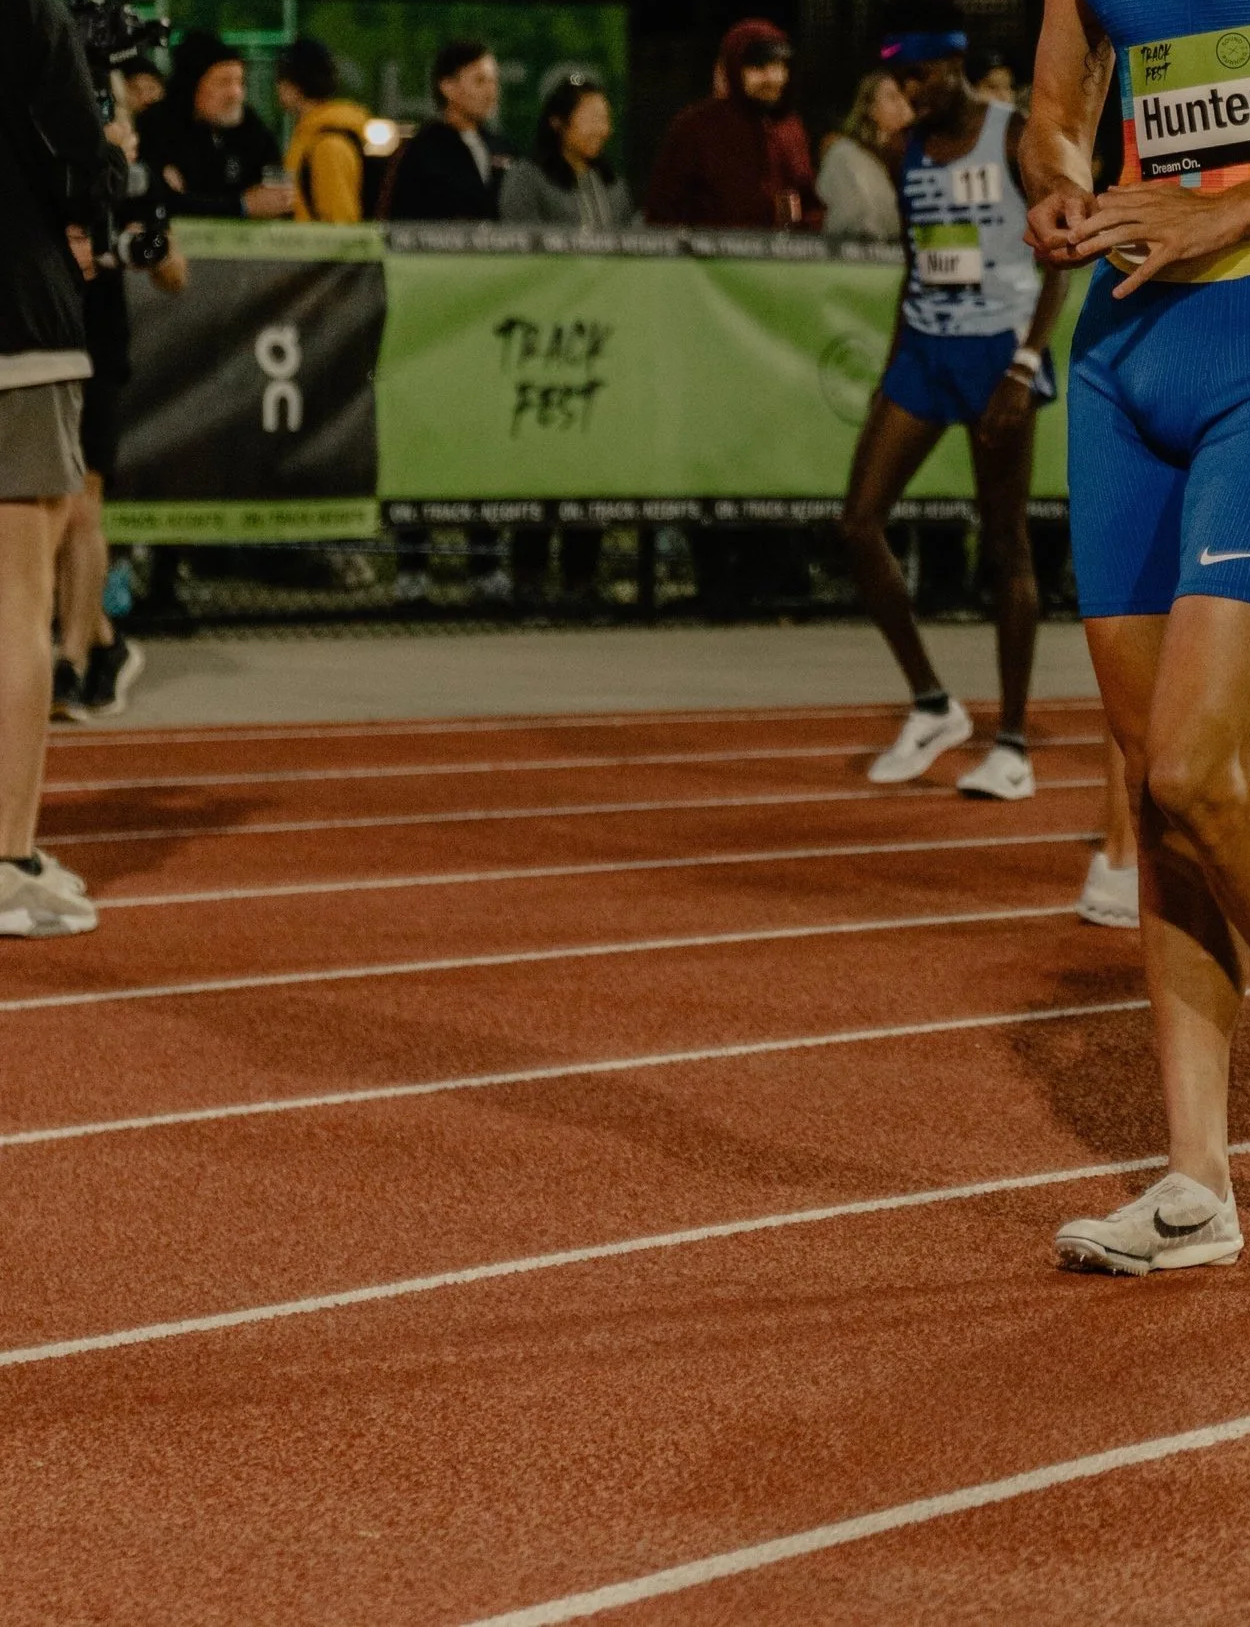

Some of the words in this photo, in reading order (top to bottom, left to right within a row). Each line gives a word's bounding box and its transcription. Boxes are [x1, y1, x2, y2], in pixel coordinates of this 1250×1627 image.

[1141, 43, 1171, 64] TRACK
[1145, 62, 1171, 85] FEST
[1152, 161, 1181, 175] Dream
[1182, 158, 1201, 170] On.
[961, 168, 988, 199] 11
[494, 316, 614, 373] TRACK
[511, 378, 608, 440] FEST
